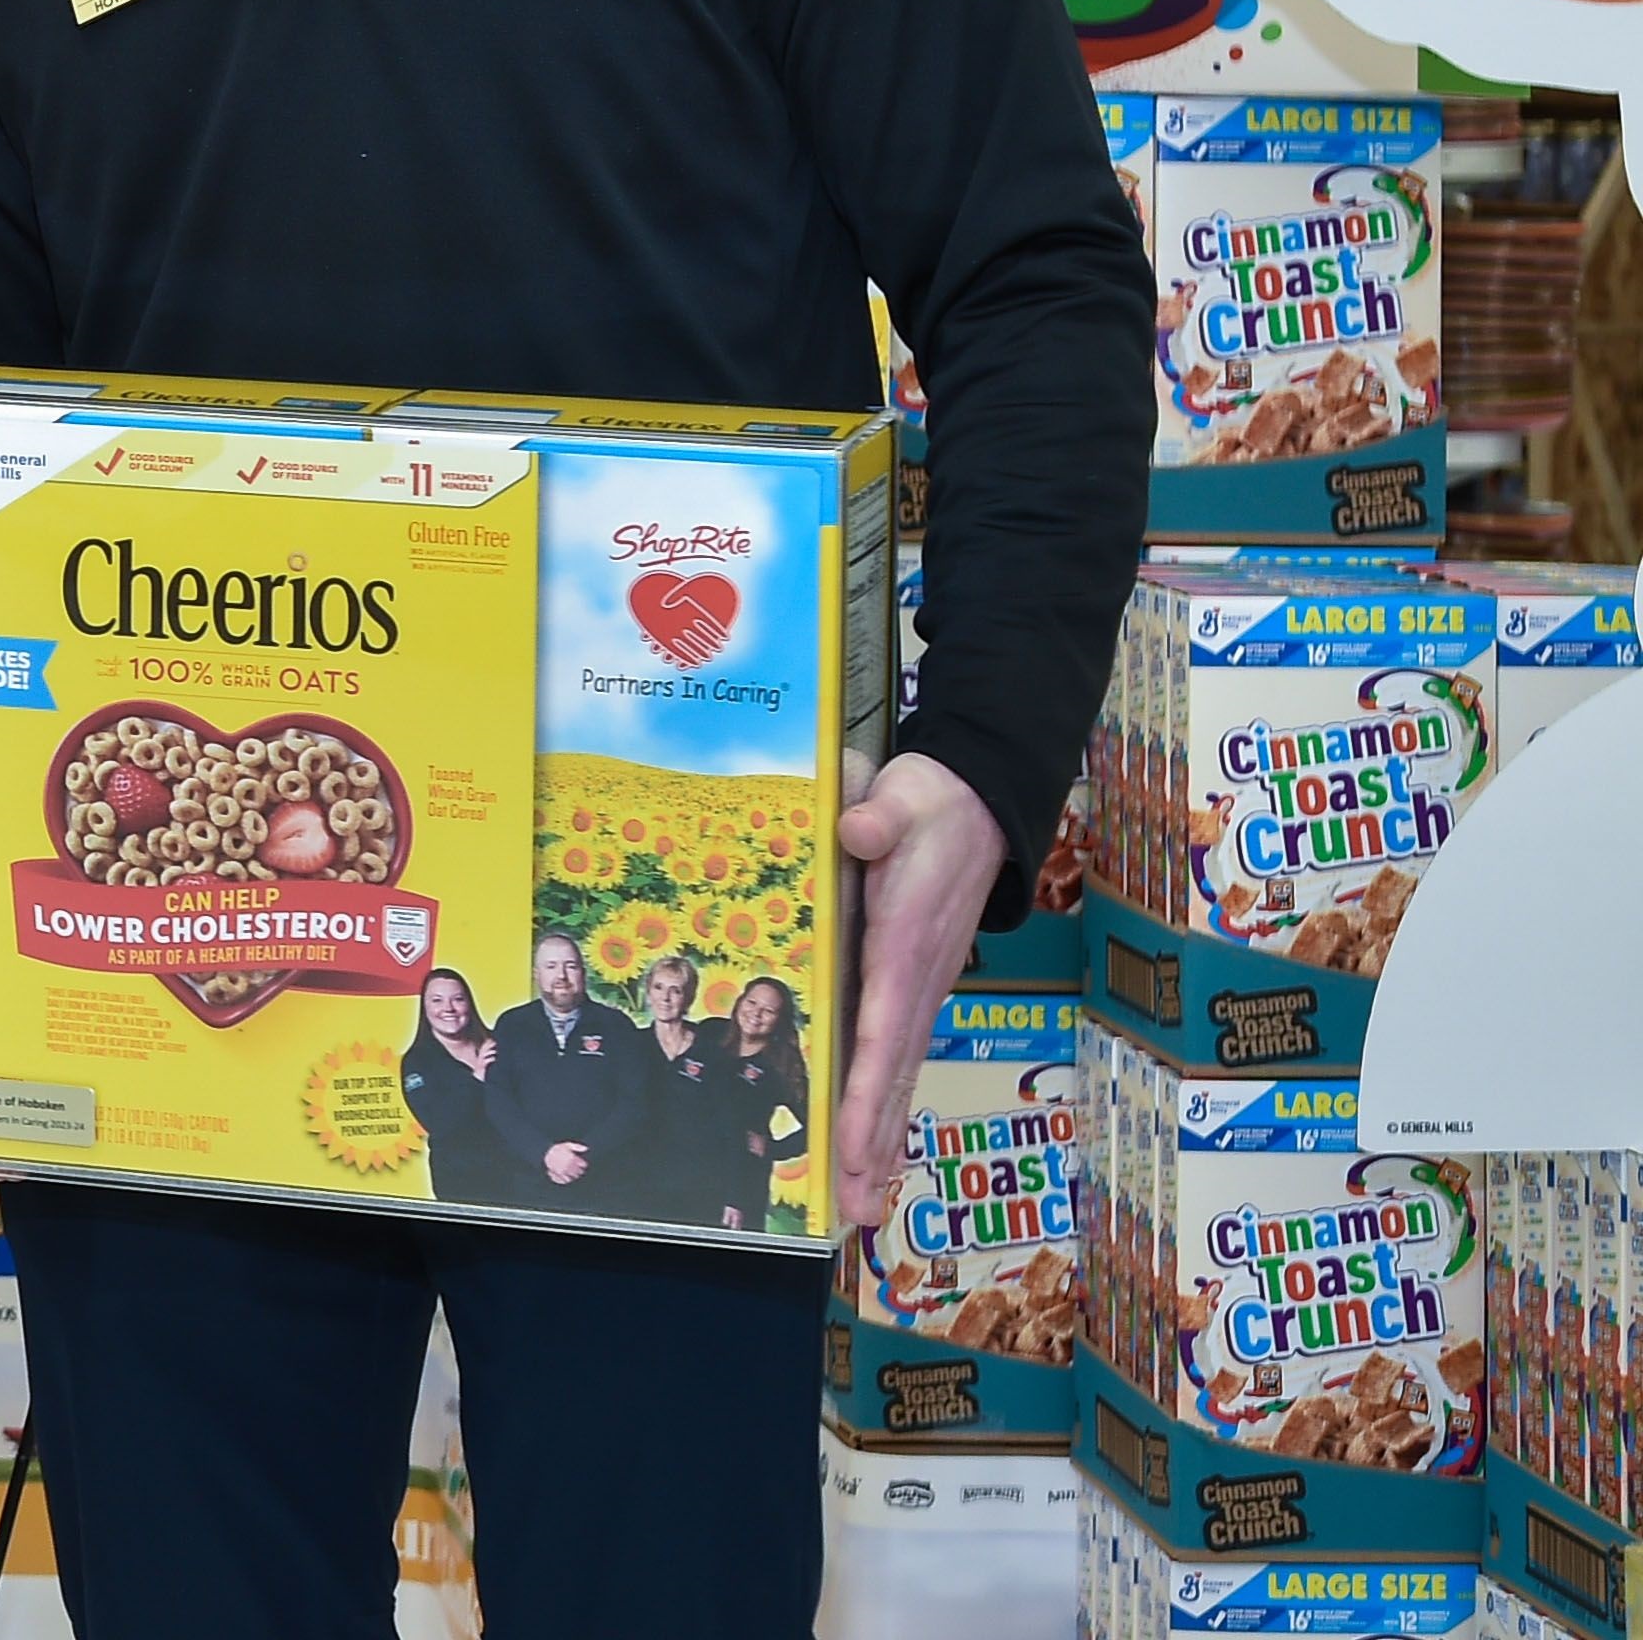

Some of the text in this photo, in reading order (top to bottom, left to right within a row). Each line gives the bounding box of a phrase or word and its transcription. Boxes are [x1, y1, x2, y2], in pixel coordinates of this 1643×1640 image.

[1246, 107, 1411, 133] LARGE SIZE
[1191, 205, 1395, 263] Cinnamon
[1228, 248, 1361, 304] Toast
[1207, 280, 1398, 353] Crunch
[609, 523, 750, 567] ShopRite
[62, 538, 399, 656] Cheerios
[1286, 607, 1465, 633] LARGE SIZE
[582, 669, 674, 698] Partners
[682, 677, 706, 700] In
[1225, 713, 1446, 777] Cinnamon
[1272, 758, 1410, 818] Toast
[1244, 791, 1450, 872] Crunch
[34, 904, 372, 944] LOWER CHOLESTEROL
[1401, 1121, 1473, 1134] GENERAL MILLS
